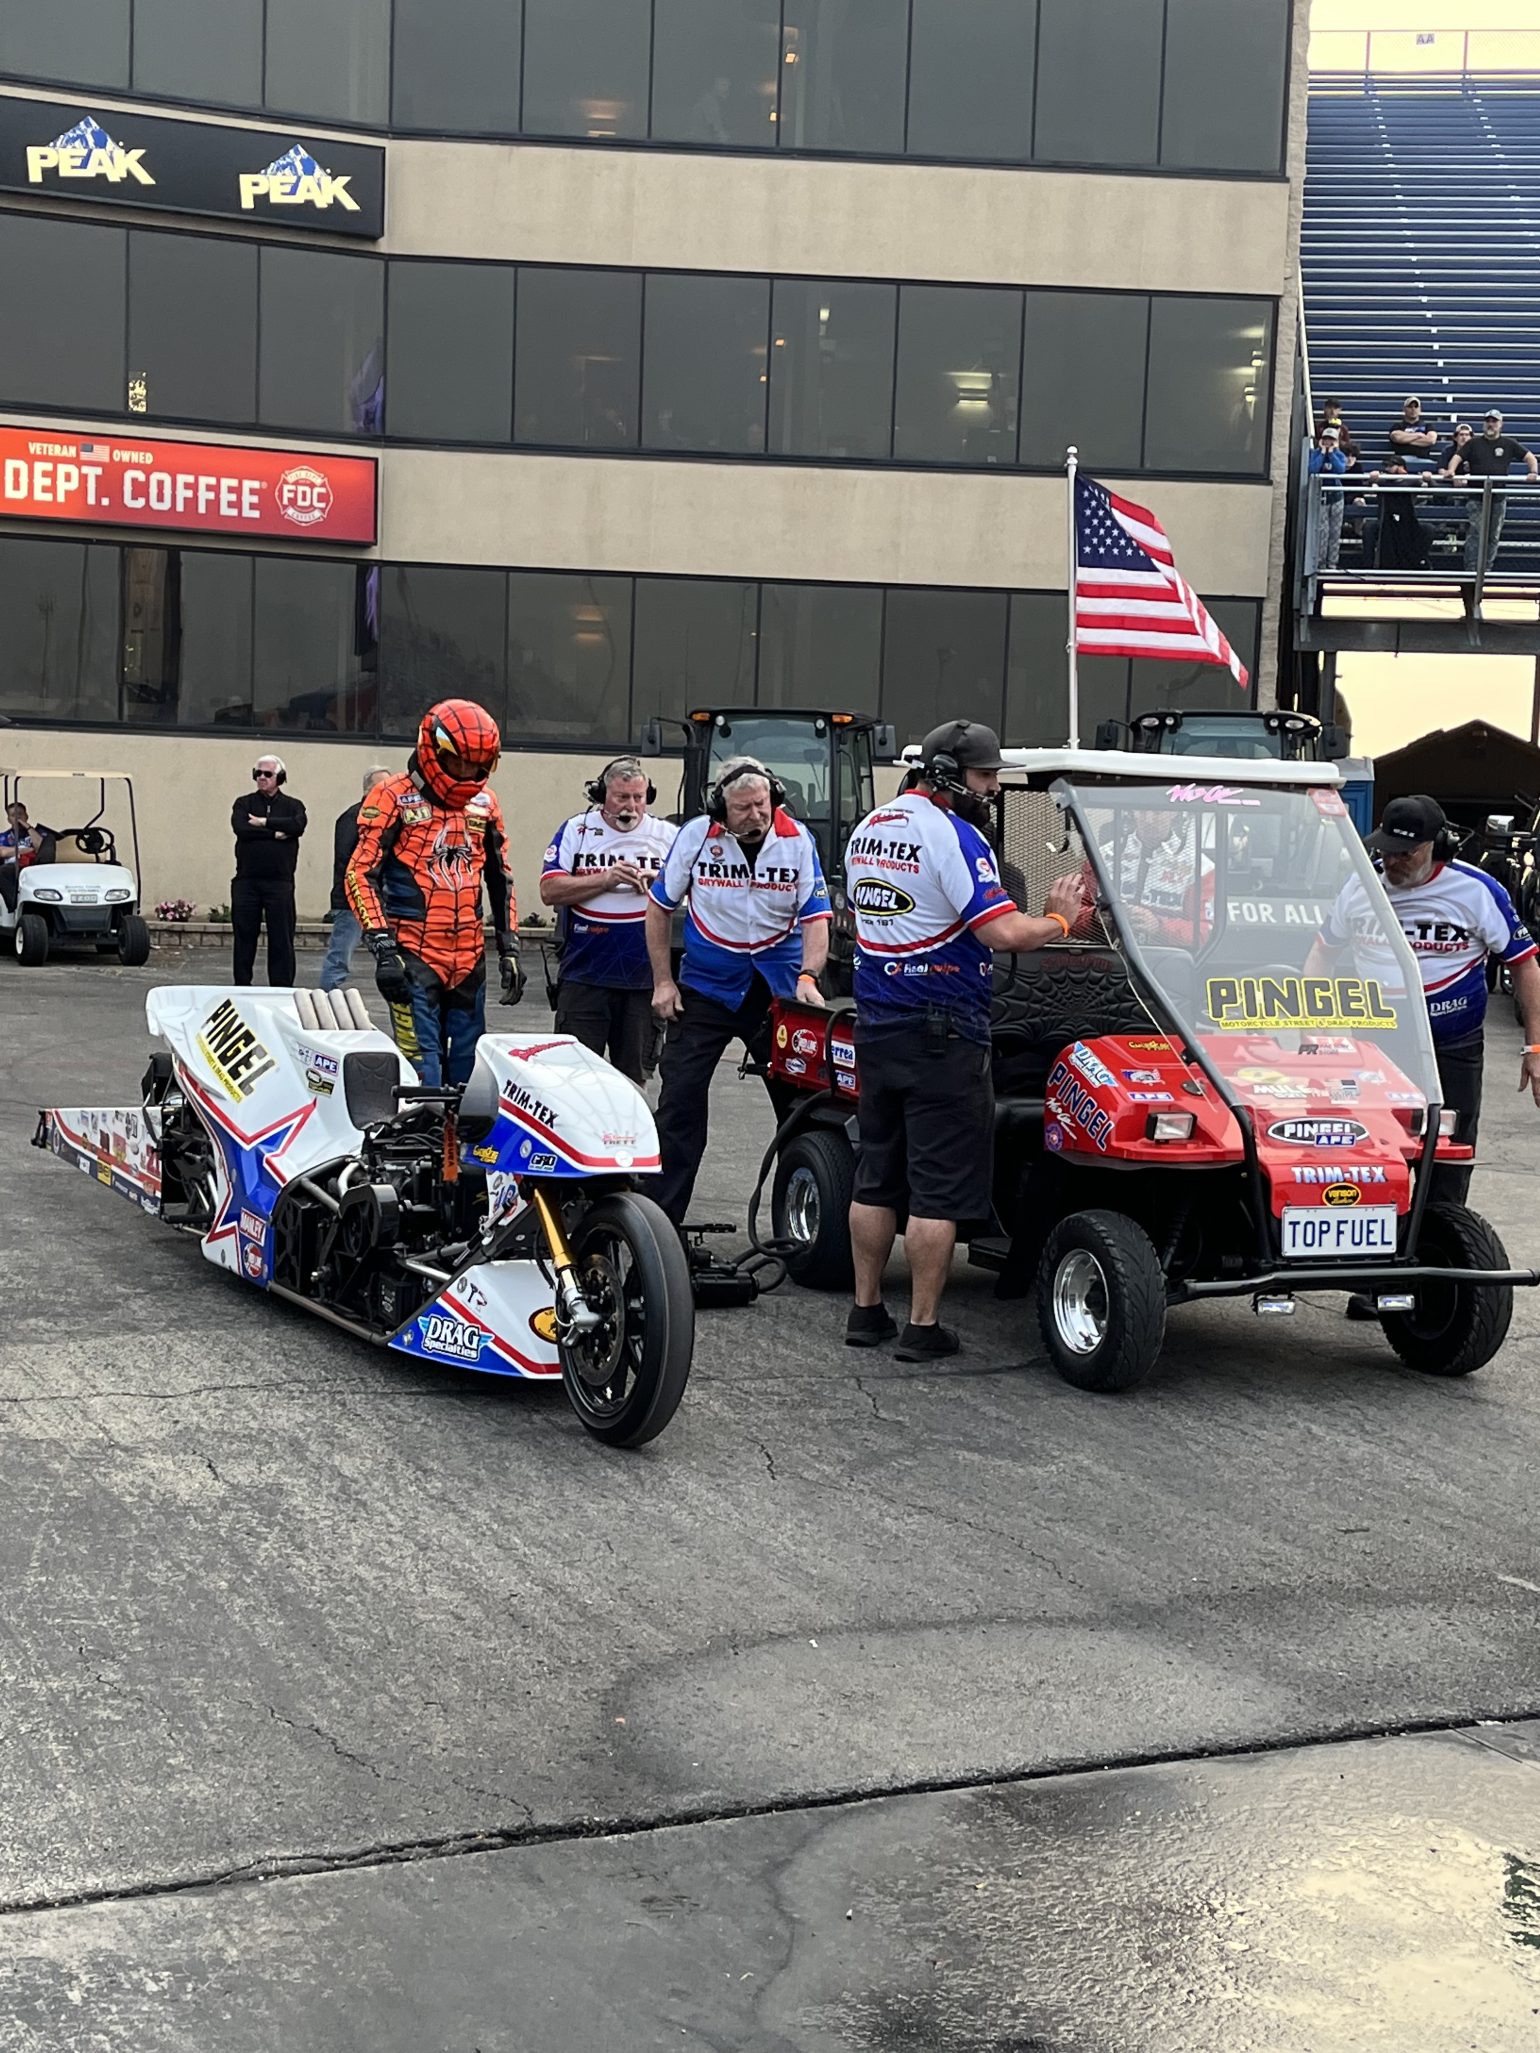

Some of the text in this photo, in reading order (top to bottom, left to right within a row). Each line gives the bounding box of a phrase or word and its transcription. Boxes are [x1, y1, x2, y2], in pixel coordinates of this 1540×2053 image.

[26, 145, 156, 184] PEAK
[239, 173, 361, 210] PEAK
[28, 442, 153, 464] VETERAN OWNED
[4, 459, 261, 518] DEPT. COFFEE
[282, 484, 327, 508] FDC
[698, 878, 743, 888] DRYWALL
[1227, 902, 1277, 923] FOR
[1207, 978, 1396, 1021] PINGEL
[1431, 997, 1467, 1013] DRAG
[1222, 1020, 1280, 1028] MOTORCYCLE
[1352, 1020, 1396, 1028] PRODUCTS
[201, 999, 275, 1096] PINGEL
[832, 1044, 853, 1060] errea
[315, 1055, 337, 1073] APE
[503, 1079, 559, 1129] TRIM-TEX
[1047, 1062, 1115, 1152] PINGEL
[1318, 1135, 1353, 1145] APE
[1291, 1165, 1387, 1184] TRIM-TEX
[1288, 1218, 1393, 1248] TOP FUEL
[427, 1317, 480, 1350] DRAG
[424, 1337, 477, 1359] Specialties
